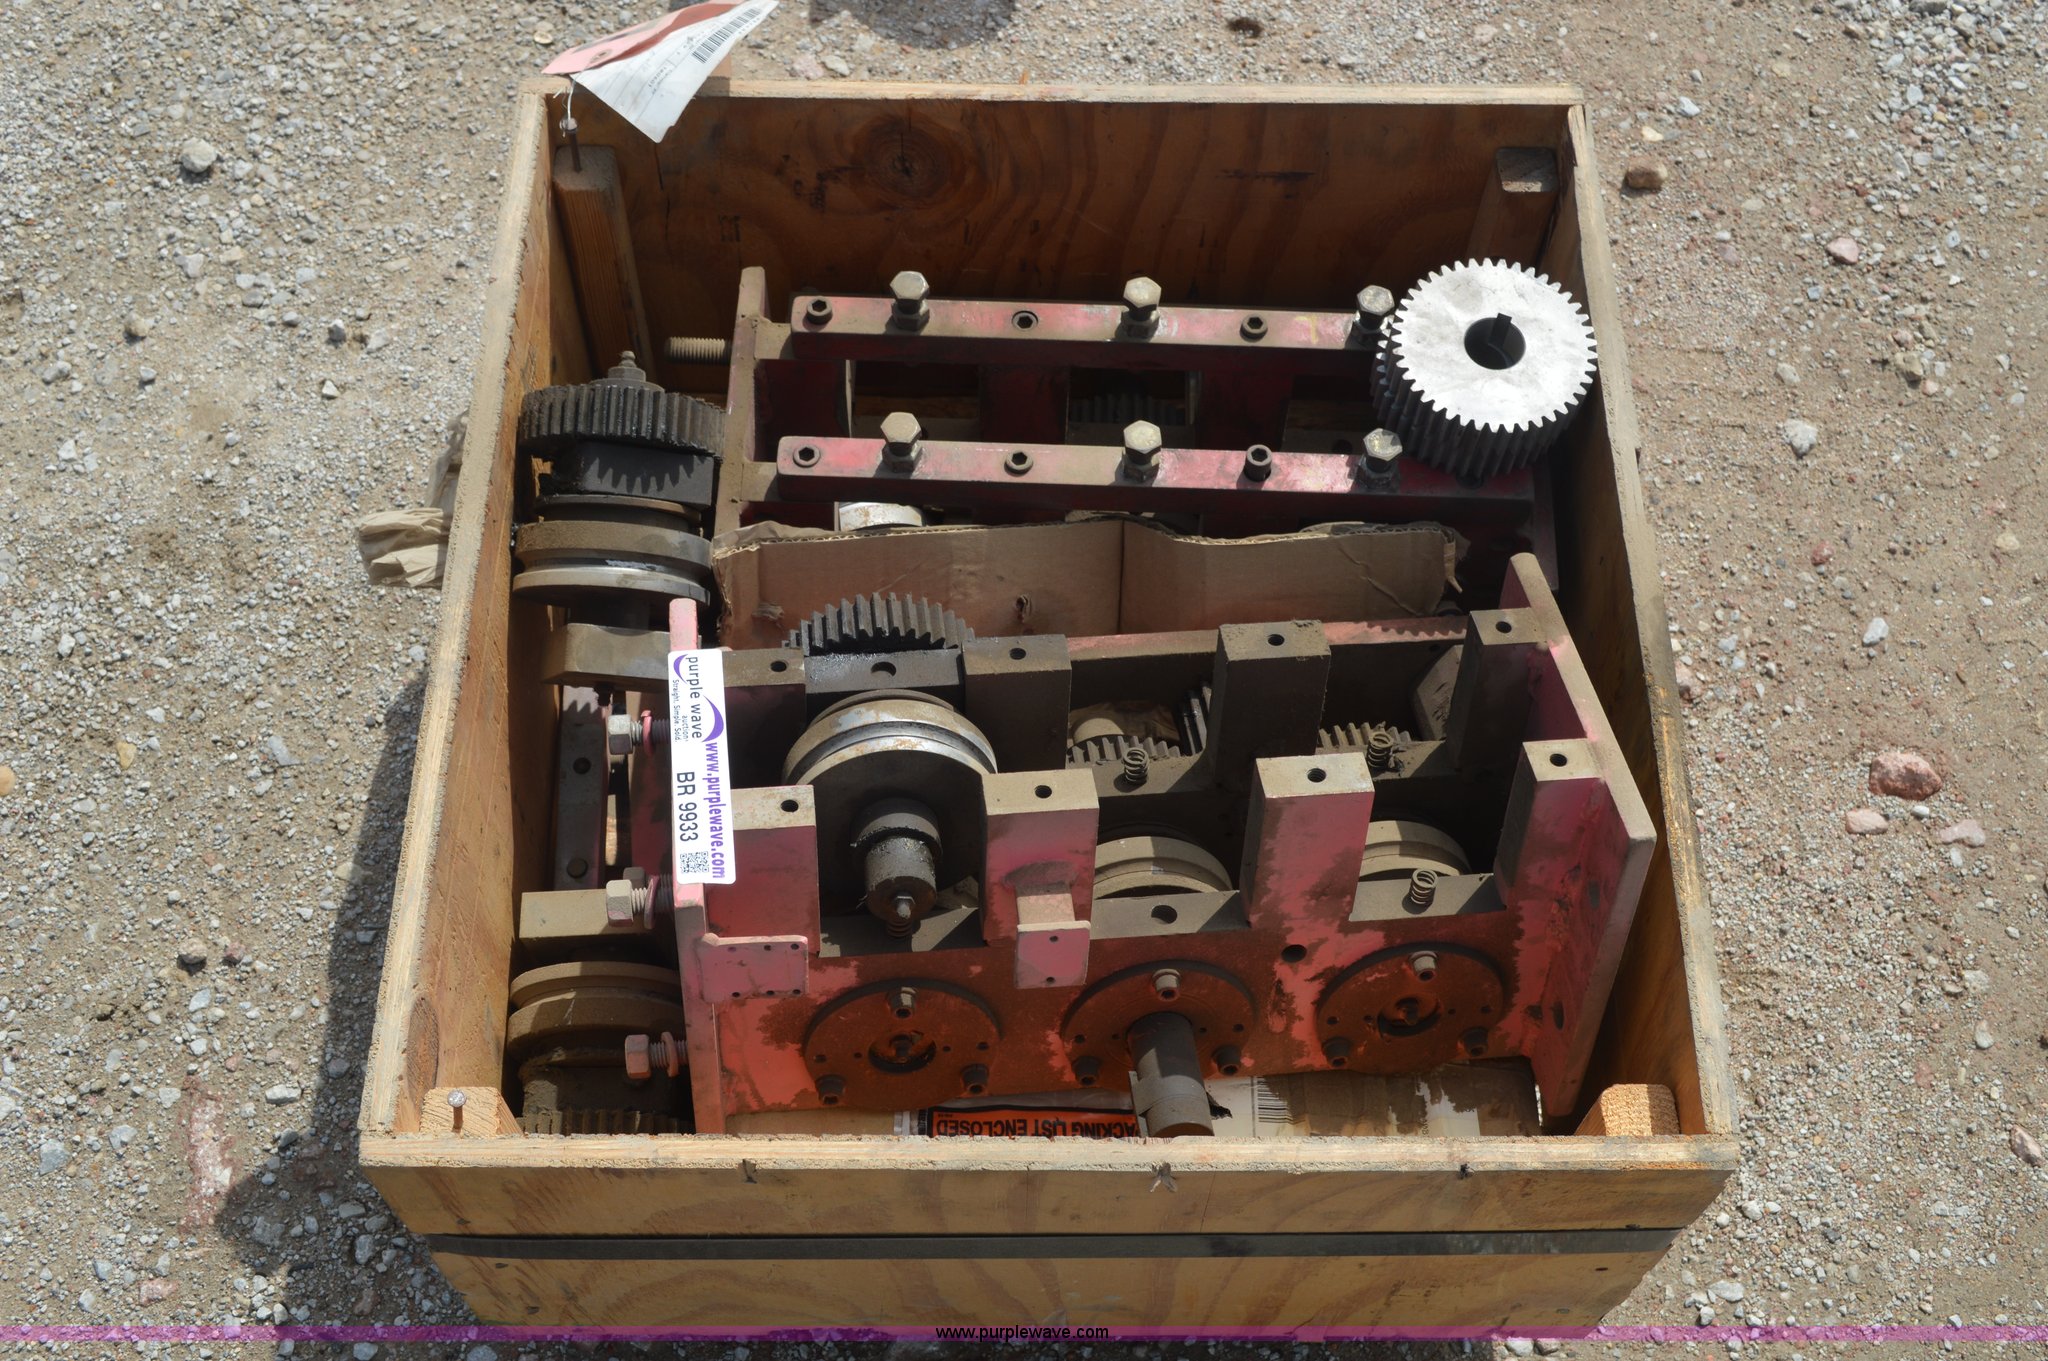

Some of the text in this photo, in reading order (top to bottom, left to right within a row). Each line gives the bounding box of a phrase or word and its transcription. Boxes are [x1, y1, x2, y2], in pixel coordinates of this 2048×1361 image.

[671, 679, 682, 742] Straight. Simple. Sold.
[685, 656, 704, 739] purple wave
[676, 771, 699, 842] BR 9933
[702, 742, 727, 879] www.purplewave.com
[936, 1119, 1028, 1137] ENCLOSED
[1032, 1119, 1067, 1137] LIST
